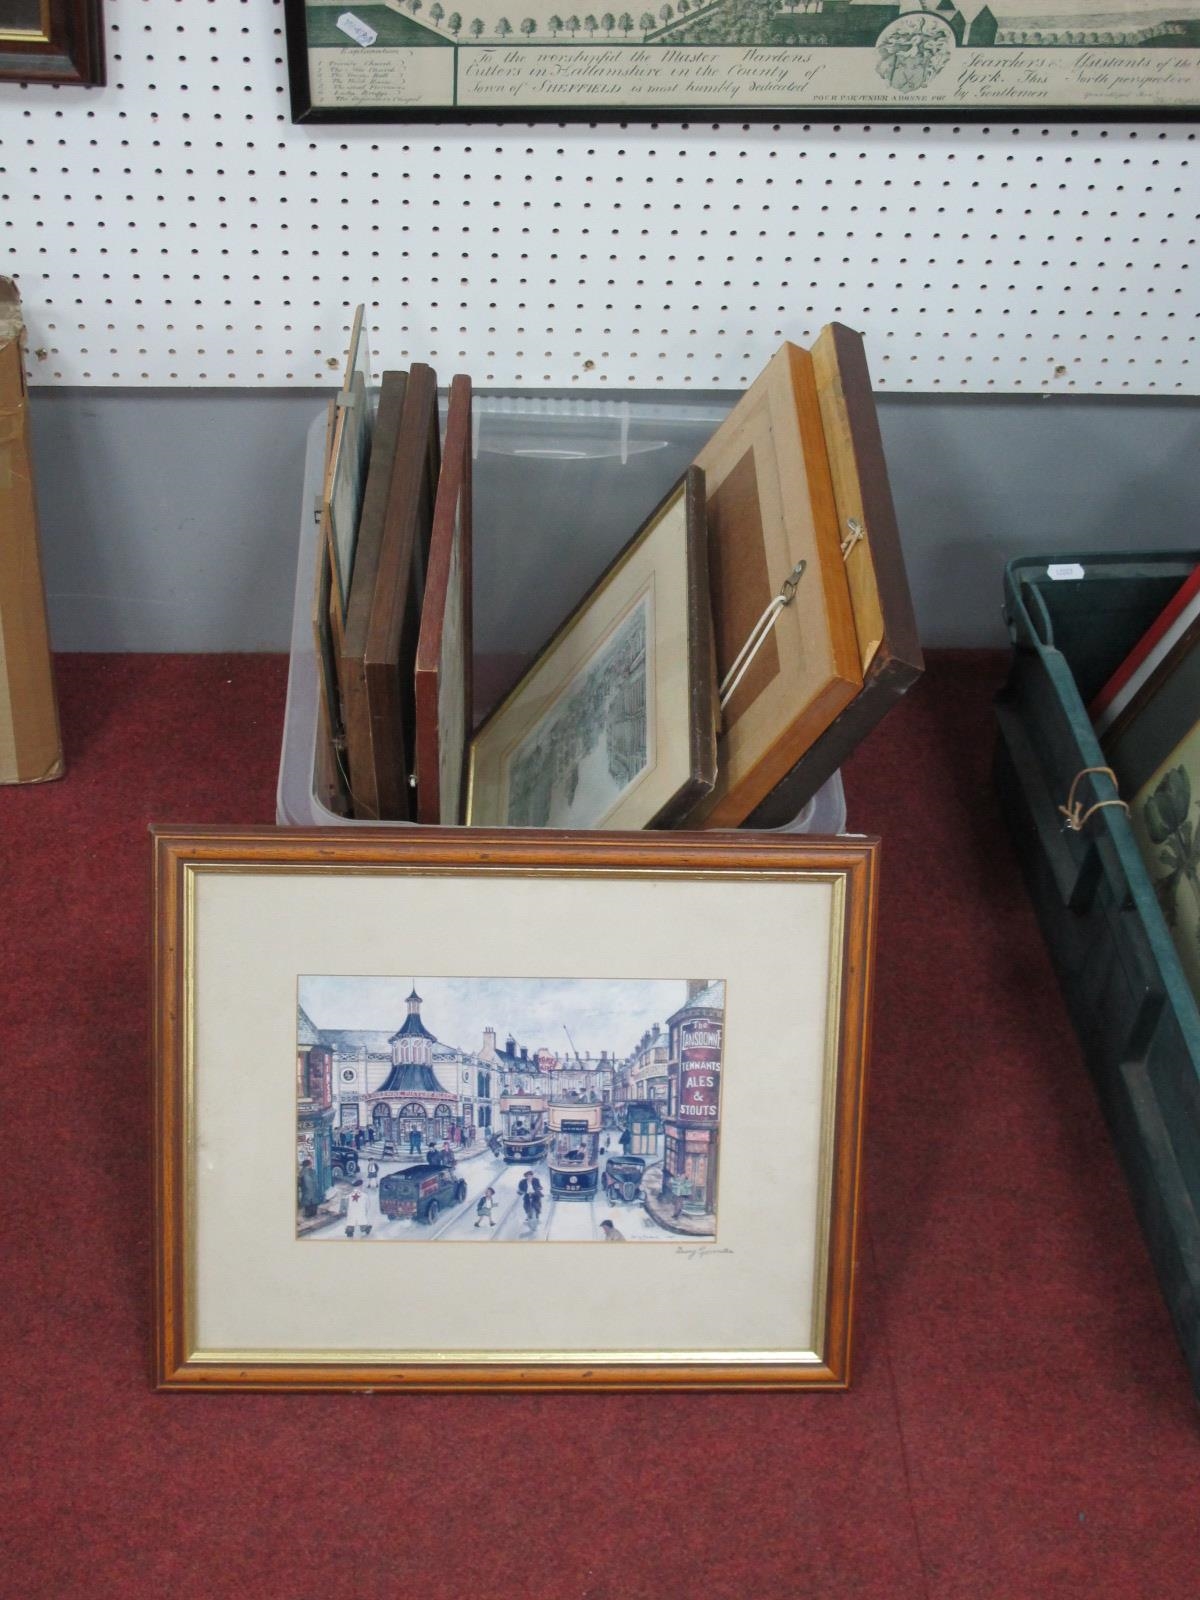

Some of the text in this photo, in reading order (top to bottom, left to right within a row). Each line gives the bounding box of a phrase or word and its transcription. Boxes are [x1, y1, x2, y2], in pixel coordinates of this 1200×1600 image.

[503, 50, 526, 63] the
[630, 50, 651, 62] the
[660, 50, 721, 63] Master
[465, 64, 522, 77] Cutlers
[529, 68, 547, 77] in
[670, 68, 690, 77] in
[695, 64, 720, 77] the
[727, 64, 789, 83] County
[804, 64, 827, 81] of
[509, 81, 528, 96] of
[532, 79, 622, 94] SHEFFIELD
[647, 83, 679, 93] most
[686, 80, 740, 99] humbly
[681, 1061, 721, 1072] TENNANTS
[686, 1076, 714, 1088] ALES
[693, 1091, 704, 1102] &
[680, 1104, 718, 1116] STOUTS
